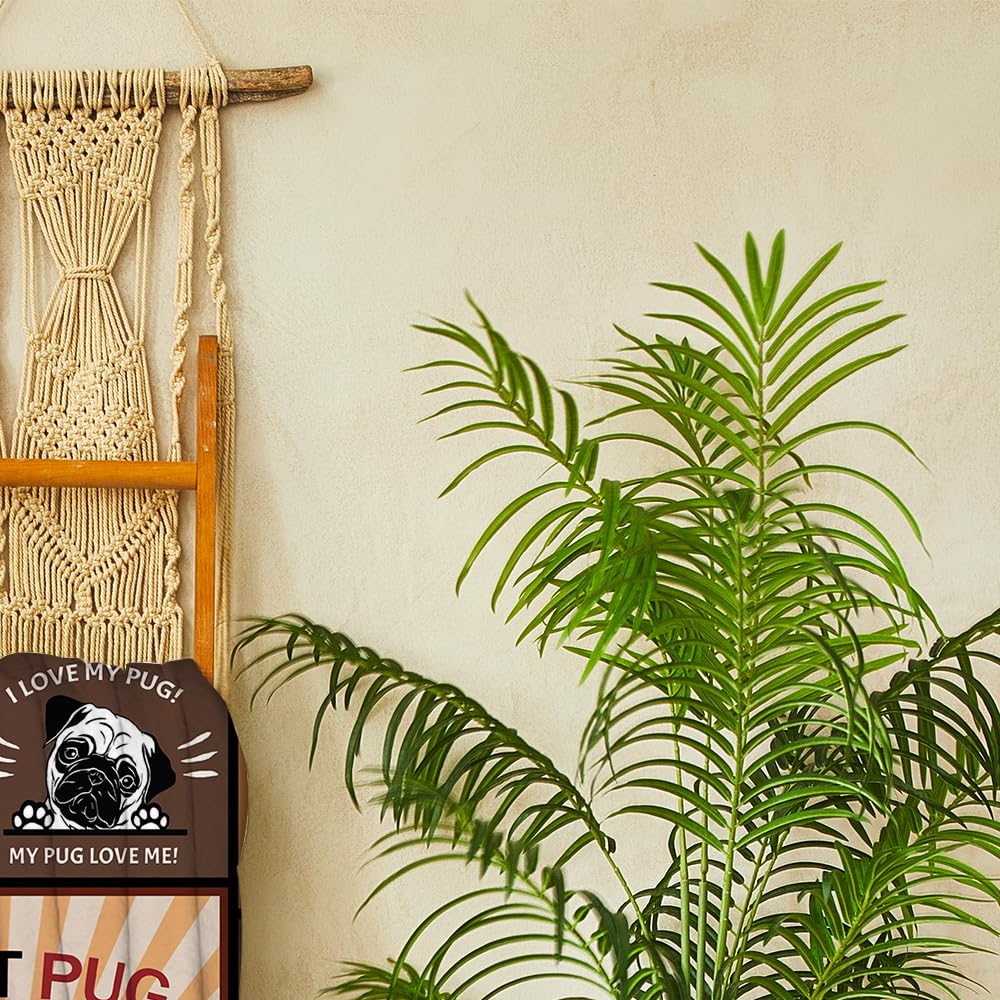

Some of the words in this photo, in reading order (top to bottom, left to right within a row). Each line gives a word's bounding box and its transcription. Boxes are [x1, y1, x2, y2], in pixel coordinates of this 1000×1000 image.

[5, 686, 18, 704] I
[18, 663, 79, 697] LOVE
[85, 663, 120, 682] MY
[126, 667, 184, 704] PUG!
[9, 847, 38, 864] MY
[44, 847, 84, 864] PUG
[90, 847, 139, 864] LOVE
[144, 847, 178, 864] ME!
